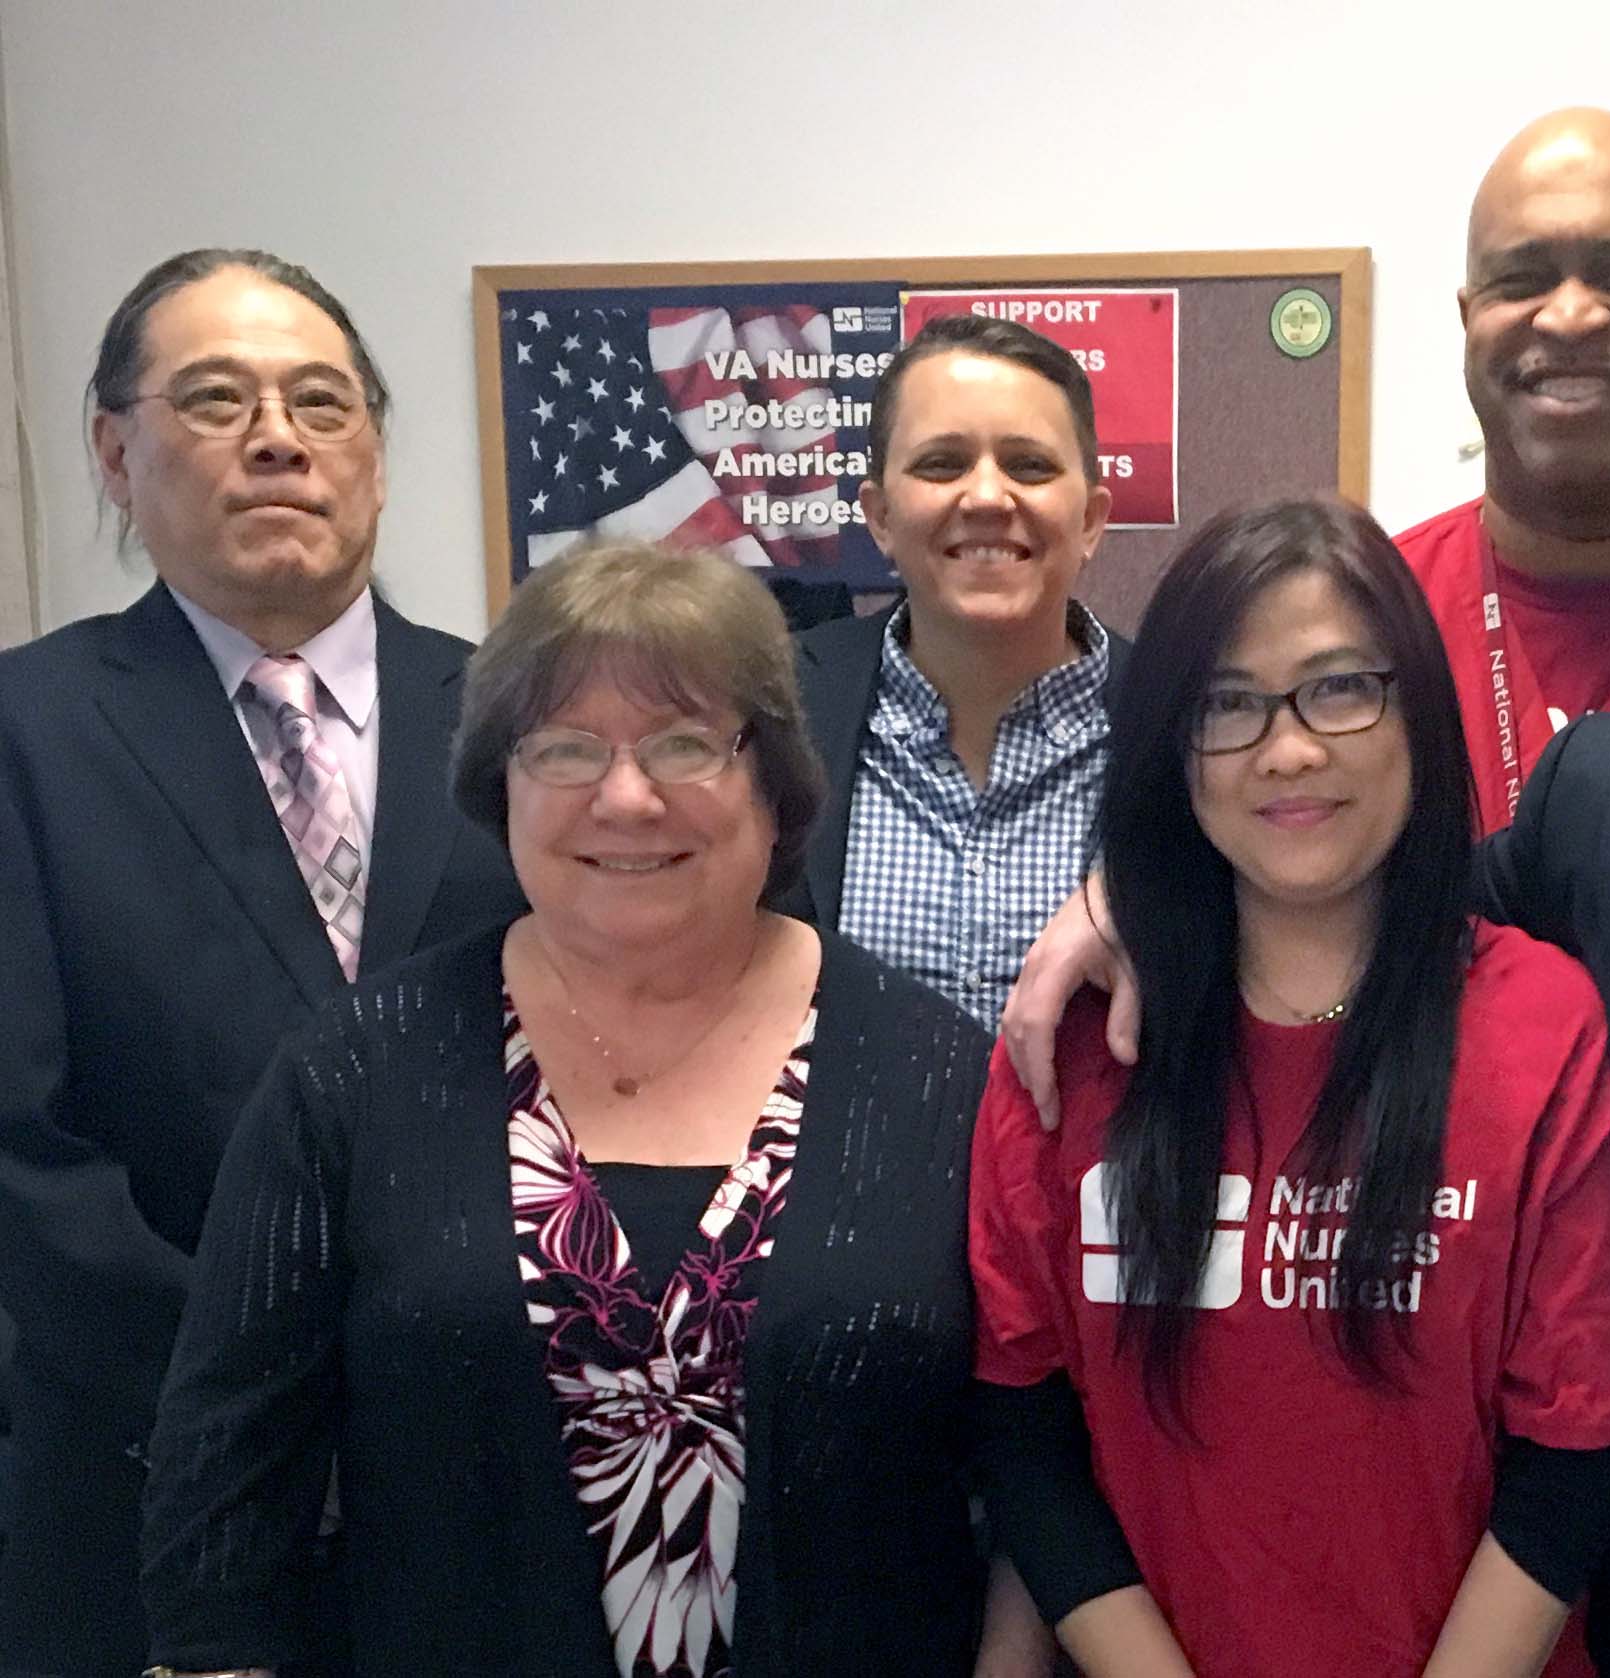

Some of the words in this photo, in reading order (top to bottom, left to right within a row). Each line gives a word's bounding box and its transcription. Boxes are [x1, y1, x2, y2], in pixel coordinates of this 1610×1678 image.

[971, 301, 1102, 322] SUPPORT
[704, 349, 757, 379] VA
[767, 349, 895, 379] Nurses
[704, 396, 872, 429] Protectin
[713, 445, 872, 476] America'
[742, 495, 867, 524] Heroes
[1489, 649, 1518, 769] National
[1269, 1175, 1478, 1221] Natial
[1261, 1266, 1422, 1313] Unied
